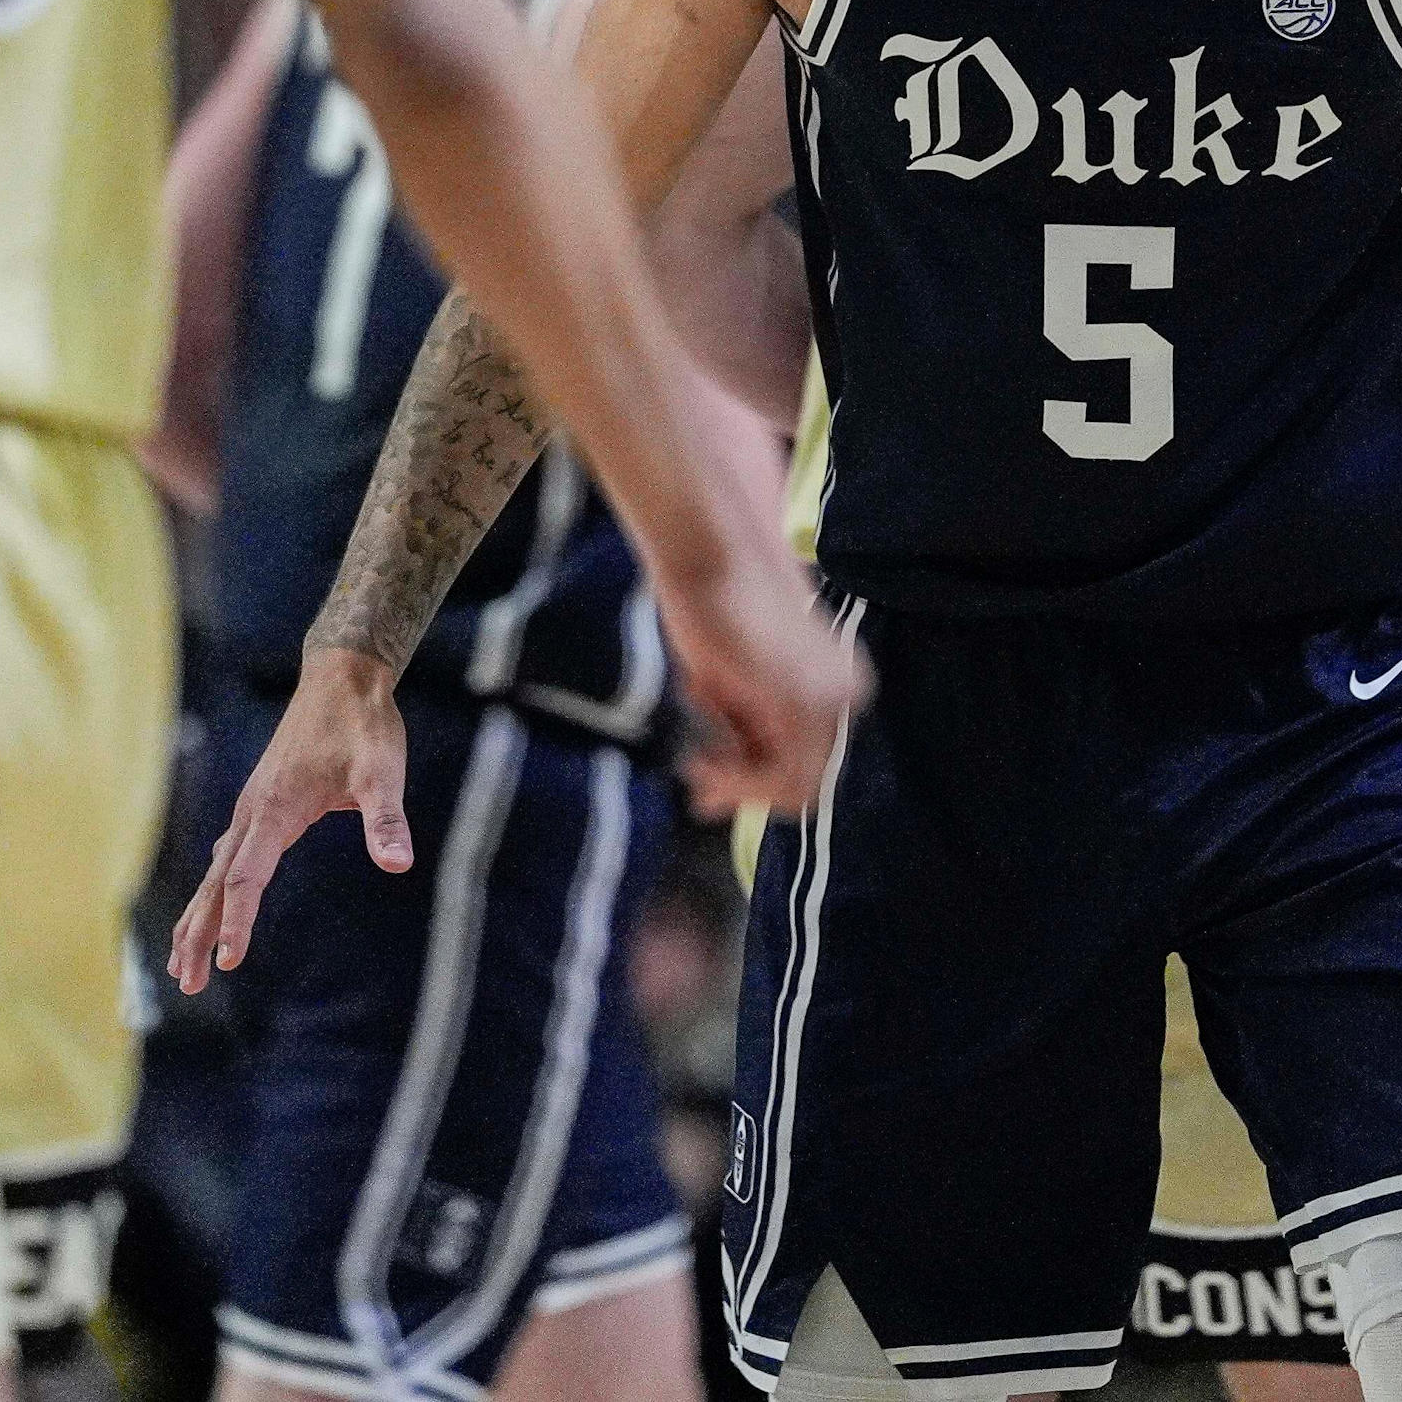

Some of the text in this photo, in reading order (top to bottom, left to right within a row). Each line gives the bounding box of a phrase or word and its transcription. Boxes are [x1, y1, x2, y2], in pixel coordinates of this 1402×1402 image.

[878, 32, 1344, 188] Duke
[304, 78, 396, 400] 7
[1041, 222, 1177, 463] 5
